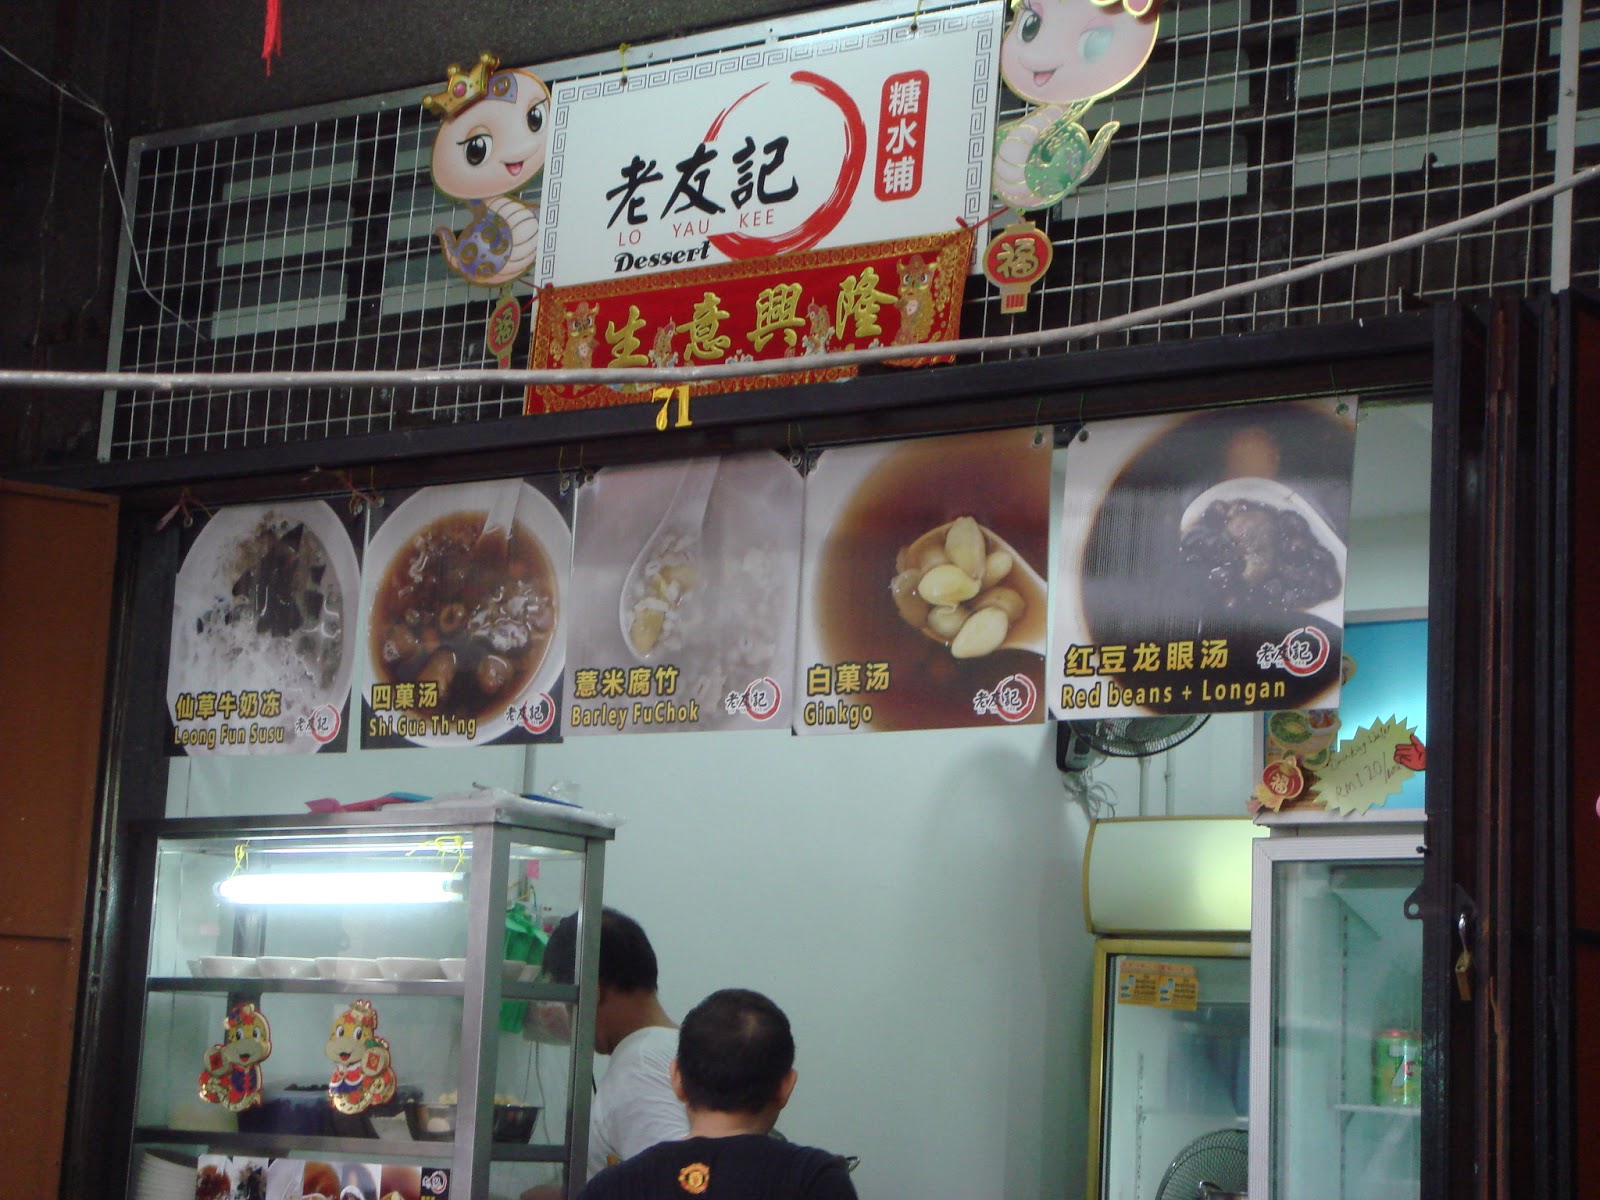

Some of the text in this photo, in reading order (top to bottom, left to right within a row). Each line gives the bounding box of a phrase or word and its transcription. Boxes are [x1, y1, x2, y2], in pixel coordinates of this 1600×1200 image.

[883, 79, 921, 194] 糖水铺
[605, 135, 799, 229] 老友記
[618, 209, 775, 247] LO YAU KEE
[614, 240, 711, 273] Dessert
[605, 266, 898, 368] 生意興隆
[652, 383, 693, 432] 71
[1064, 639, 1229, 676] 红豆龙眼汤
[574, 665, 680, 698] 薏米腐竹
[807, 662, 890, 696] 白菓汤
[1061, 679, 1286, 708] Red beans + Longan
[175, 689, 282, 720] 仙草牛奶冻
[371, 682, 439, 710] 四菓汤
[369, 715, 477, 739] Shi Gua Th'ng
[571, 699, 700, 730] Barley FuChok
[804, 700, 873, 730] Ginkgo
[174, 722, 284, 750] Leong Fun Susu
